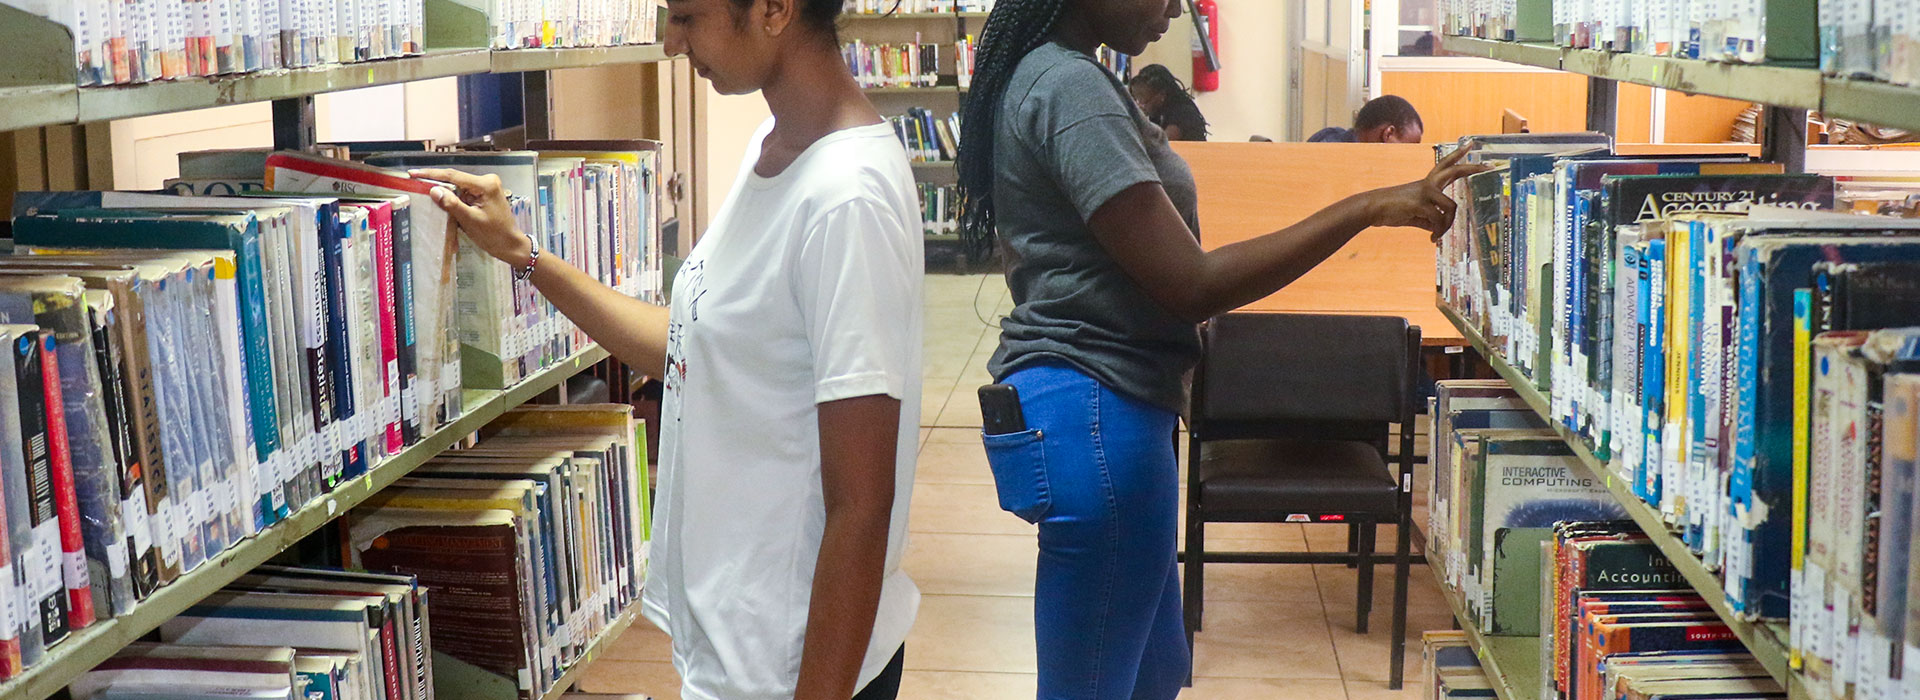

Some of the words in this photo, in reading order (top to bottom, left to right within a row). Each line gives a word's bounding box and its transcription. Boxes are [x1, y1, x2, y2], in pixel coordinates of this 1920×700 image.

[1662, 191, 1736, 202] CENTURY
[1738, 190, 1755, 201] 21
[1565, 205, 1575, 282] Introduction
[1564, 286, 1572, 299] to
[1626, 275, 1636, 342] ADVANCED
[1649, 259, 1657, 347] RECORDKEEPING
[47, 353, 61, 413] Managing
[1626, 343, 1636, 396] ACCOUN
[139, 368, 162, 495] STATISTICS
[33, 459, 50, 500] QUALITY
[1501, 477, 1593, 487] COMPUTING
[1502, 466, 1567, 478] INTERACTIVE
[1597, 569, 1690, 584] Accountin
